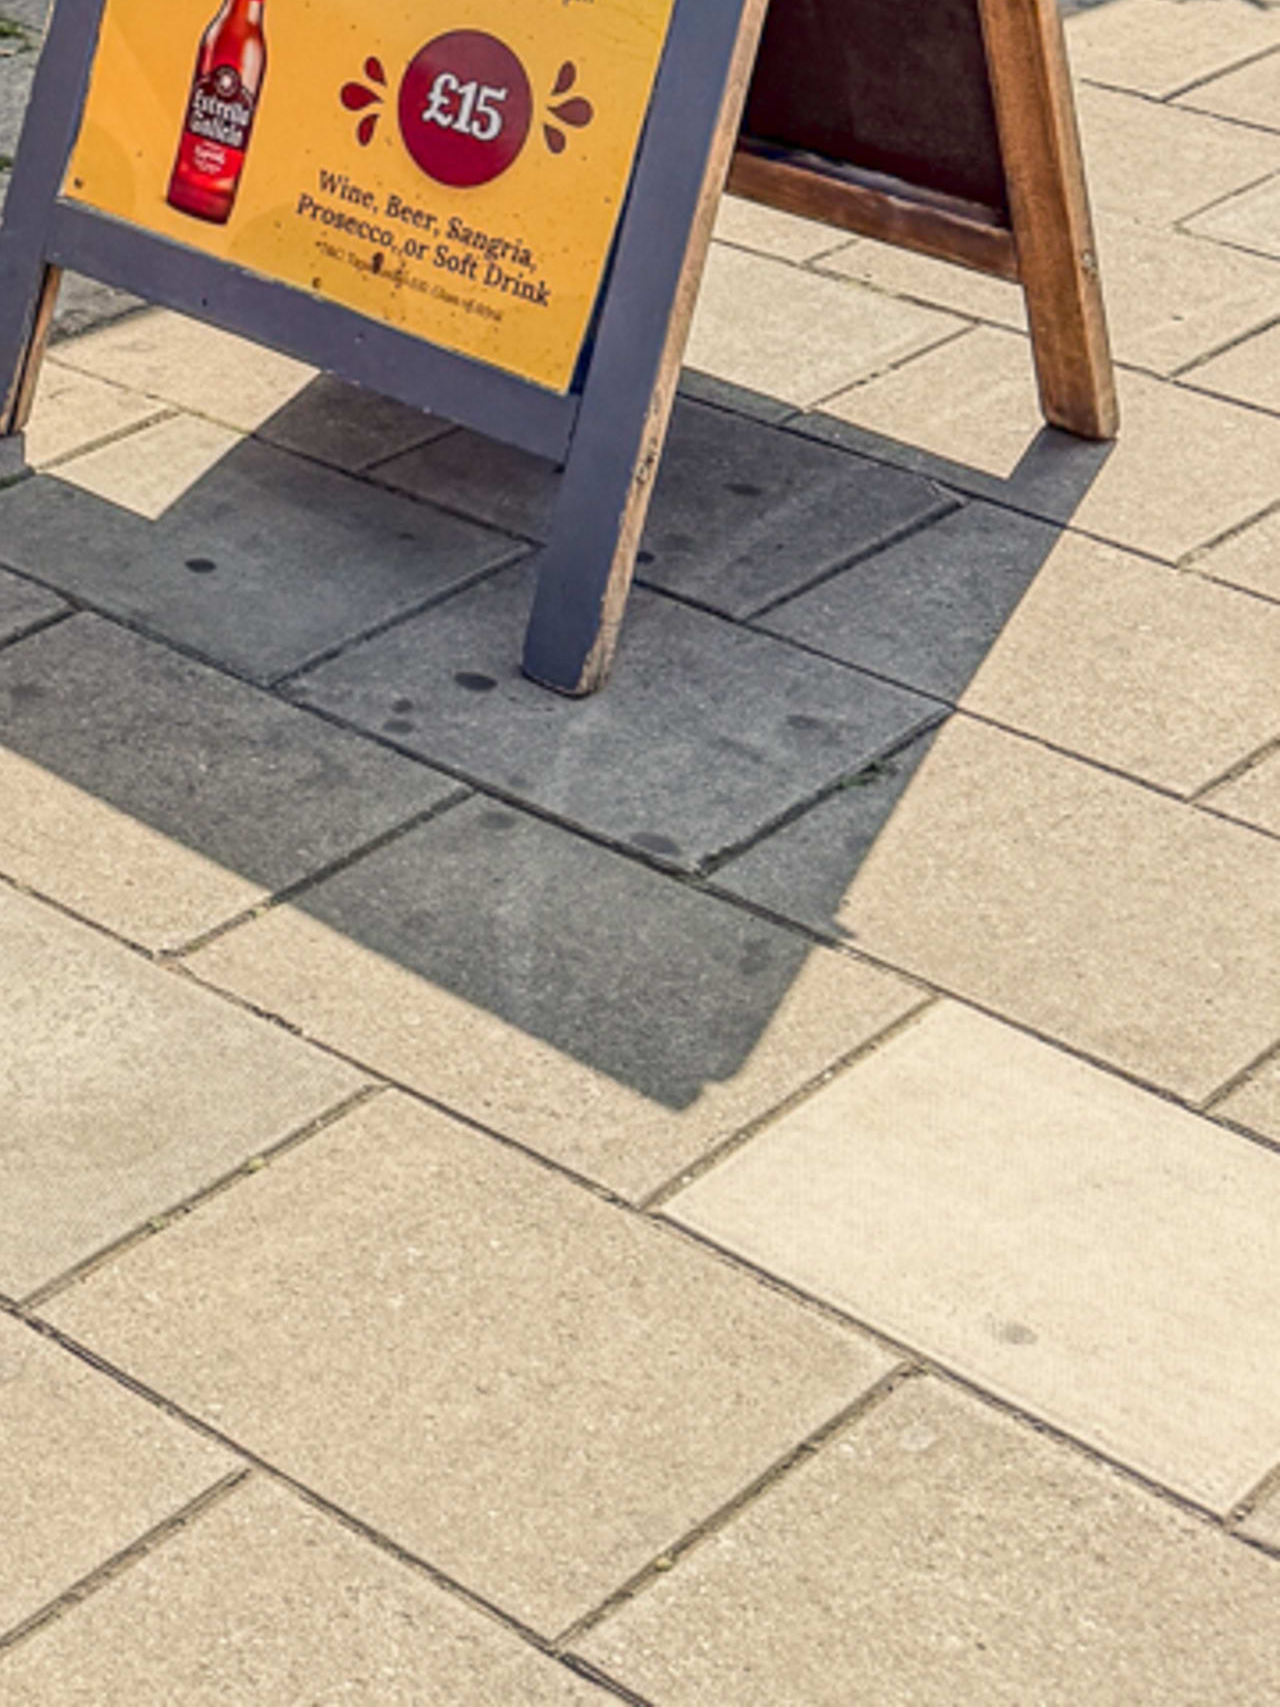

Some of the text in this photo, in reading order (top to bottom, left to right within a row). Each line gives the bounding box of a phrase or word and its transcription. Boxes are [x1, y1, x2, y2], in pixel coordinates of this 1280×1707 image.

[422, 72, 508, 141] £15
[296, 192, 397, 252] Prosecco,
[403, 238, 430, 260] or
[433, 244, 478, 280] Soft
[484, 265, 551, 307] Drink
[319, 169, 537, 272] Wine, Beer, Sangria,
